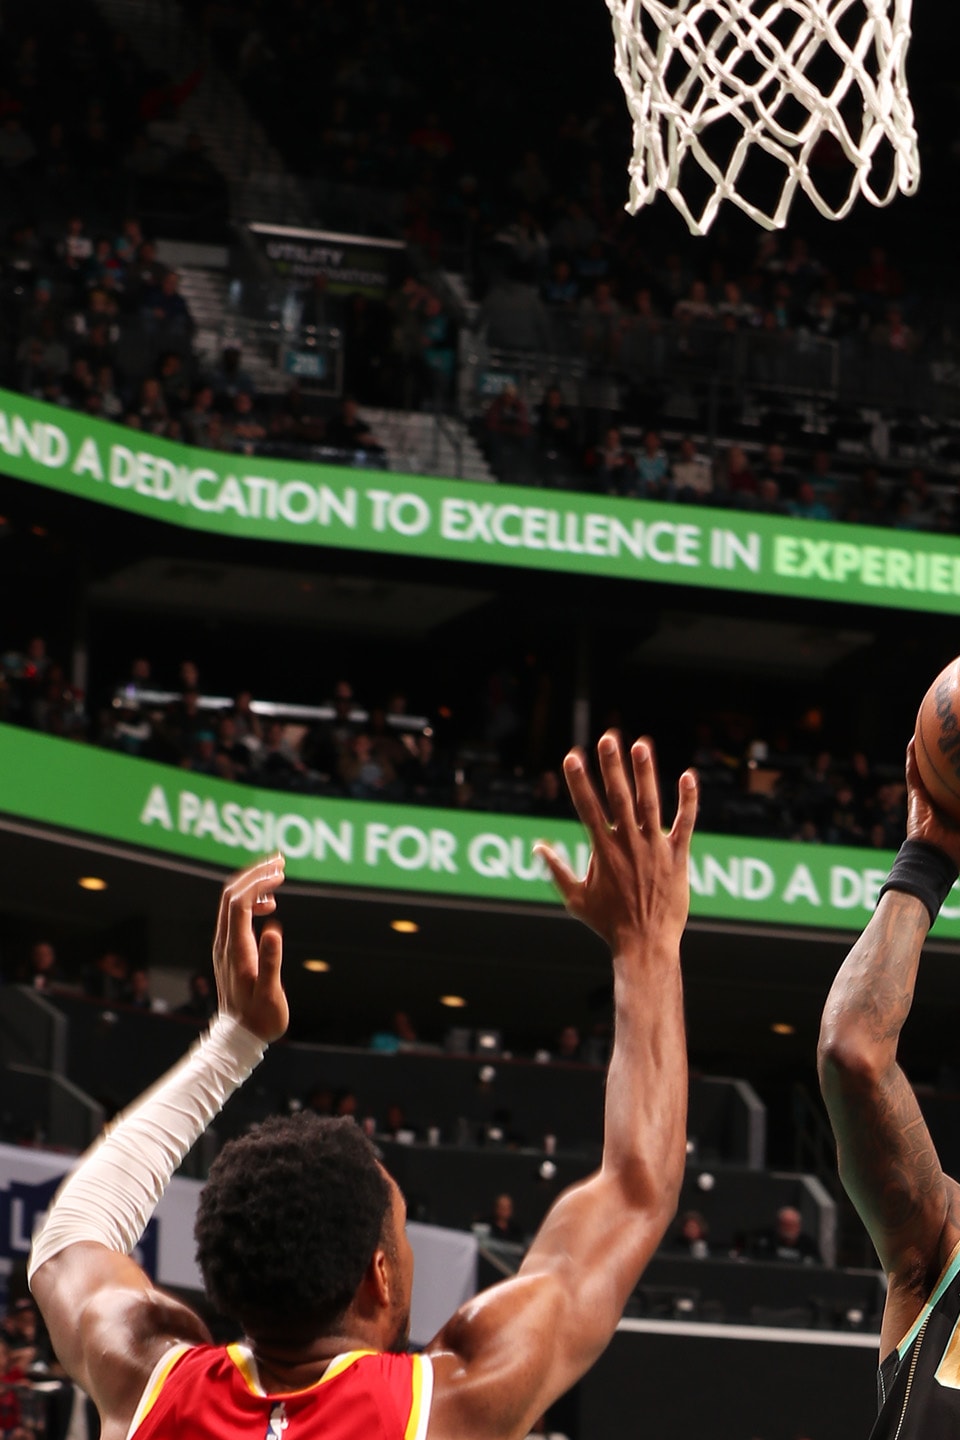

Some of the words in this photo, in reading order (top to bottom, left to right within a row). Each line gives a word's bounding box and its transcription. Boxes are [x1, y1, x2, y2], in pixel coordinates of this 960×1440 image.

[73, 436, 104, 481] A
[109, 442, 358, 529] DEDICATION
[366, 489, 430, 536] TO
[440, 497, 700, 567] EXCELLENCE
[710, 527, 761, 573] IN
[140, 785, 173, 831] A
[178, 790, 353, 863] PASSION
[364, 822, 458, 874] FOR
[783, 863, 821, 907] A
